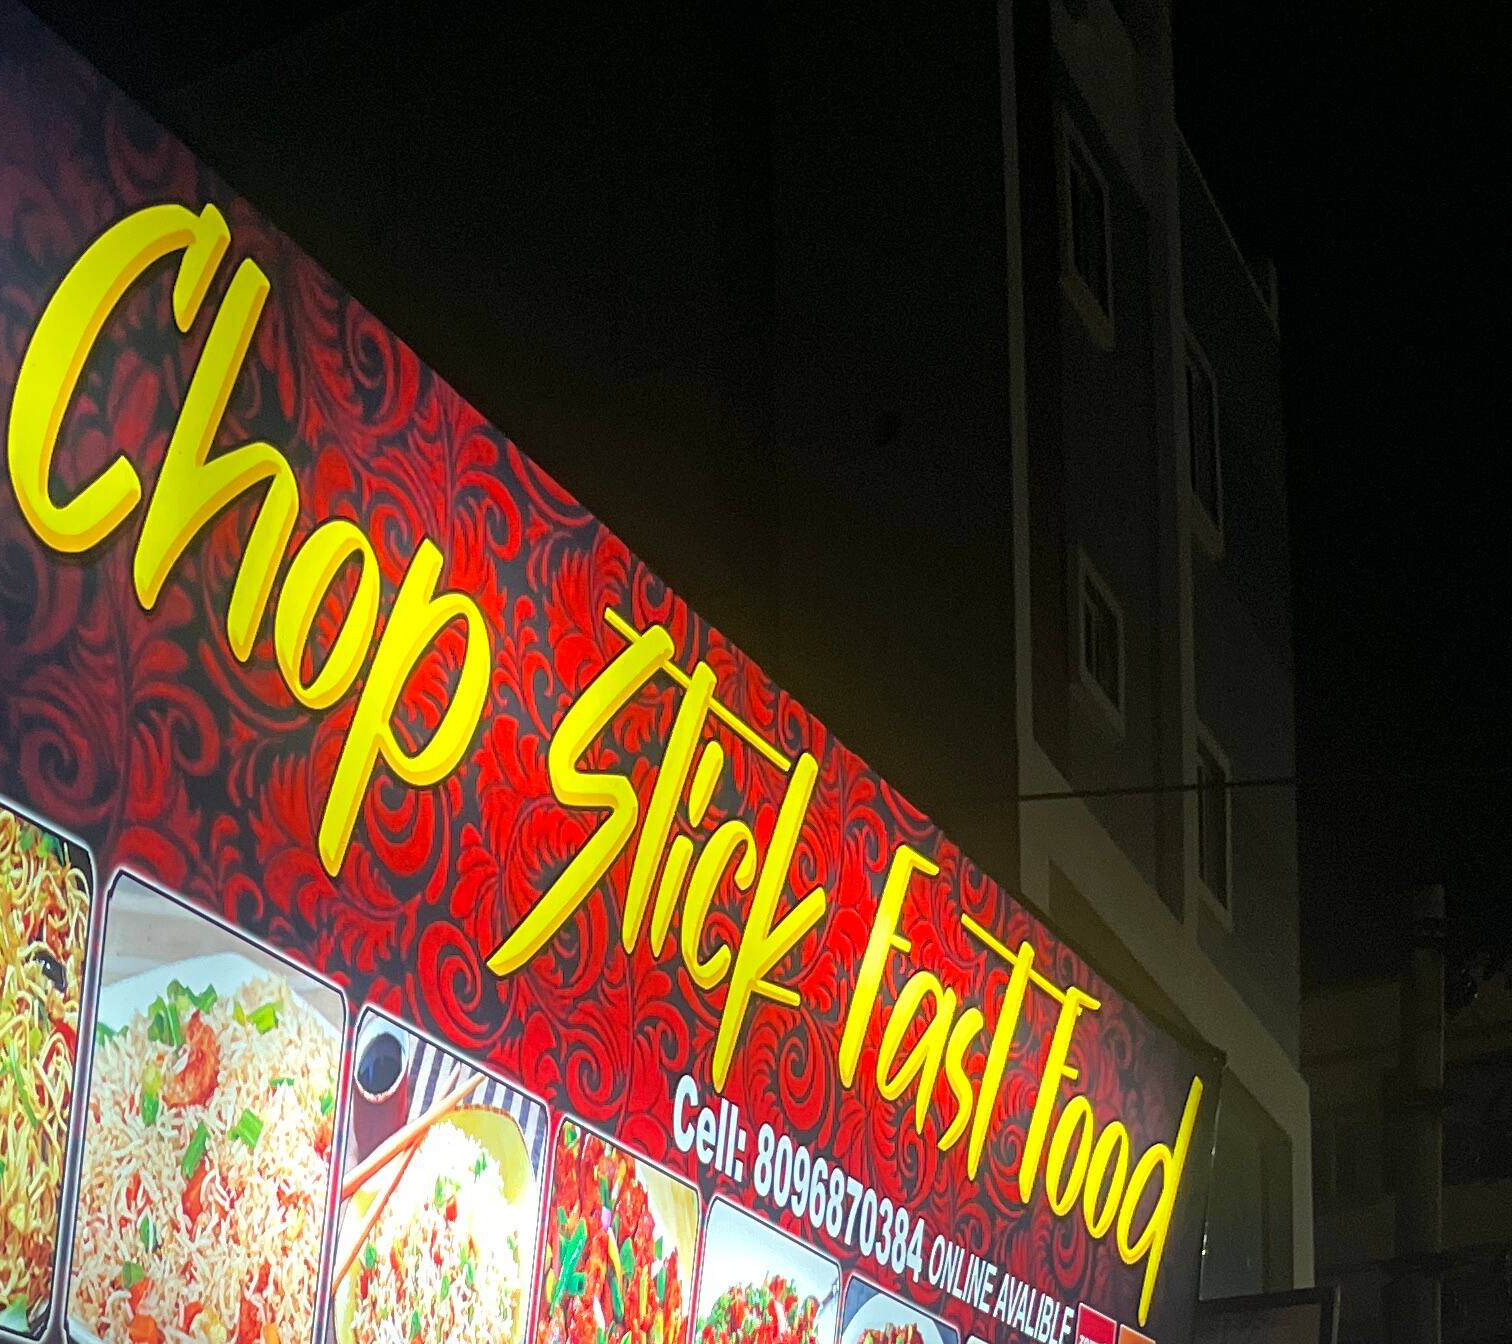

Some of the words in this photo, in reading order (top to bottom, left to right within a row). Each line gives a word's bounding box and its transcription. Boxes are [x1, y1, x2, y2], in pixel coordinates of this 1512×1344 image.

[7, 203, 491, 876] Chop
[488, 607, 826, 1092] Stick
[839, 846, 1048, 1180] Fast
[1019, 990, 1204, 1327] Food
[673, 1074, 747, 1184] Cell:
[753, 1123, 925, 1283] 8096870384
[928, 1233, 998, 1315] ONLINE
